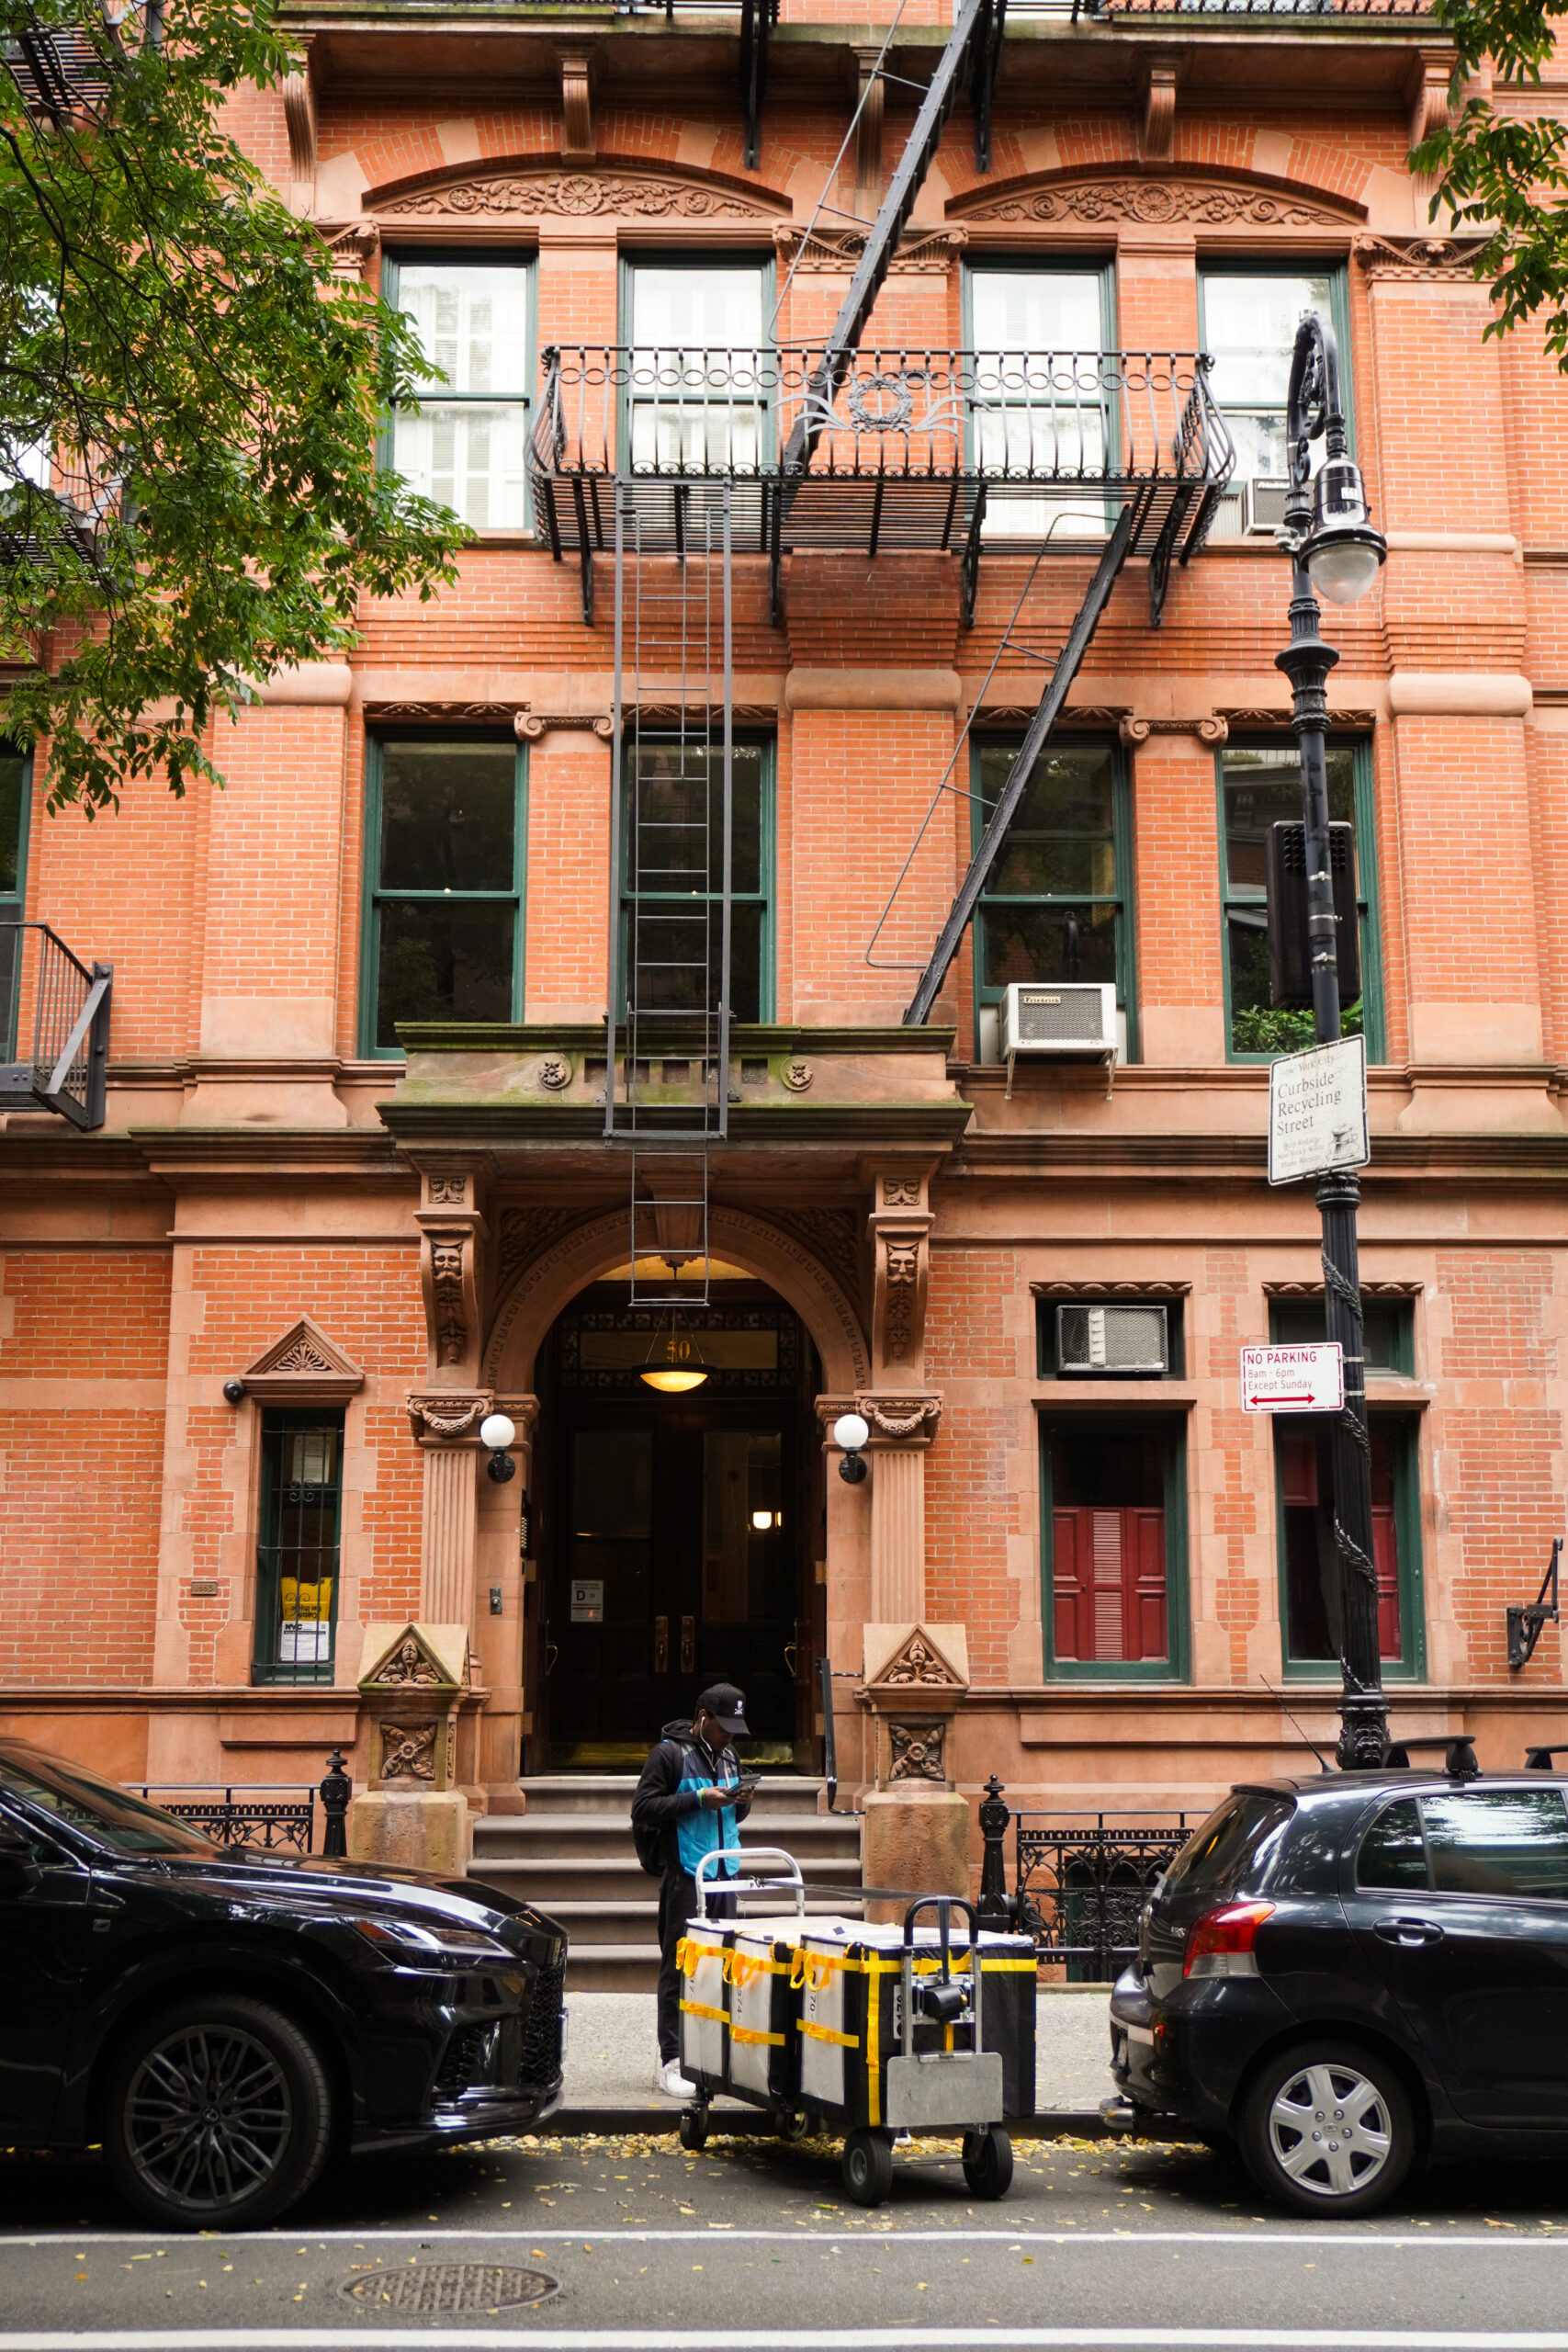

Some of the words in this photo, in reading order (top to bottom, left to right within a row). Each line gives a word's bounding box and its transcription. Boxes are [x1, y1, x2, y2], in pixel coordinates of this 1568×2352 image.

[1298, 1061, 1314, 1072] York
[1318, 1055, 1334, 1066] City
[1278, 1072, 1335, 1099] Curbside
[1278, 1090, 1342, 1117] Recycling
[1277, 1115, 1314, 1136] Street
[666, 1340, 691, 1361] 50
[1247, 1353, 1263, 1364] NO
[1267, 1351, 1317, 1364] PARKING
[1247, 1369, 1267, 1378] 8am
[1275, 1368, 1295, 1378] 6pm
[1248, 1381, 1278, 1391] Except
[1280, 1379, 1313, 1390] Sunday
[577, 1590, 585, 1600] D
